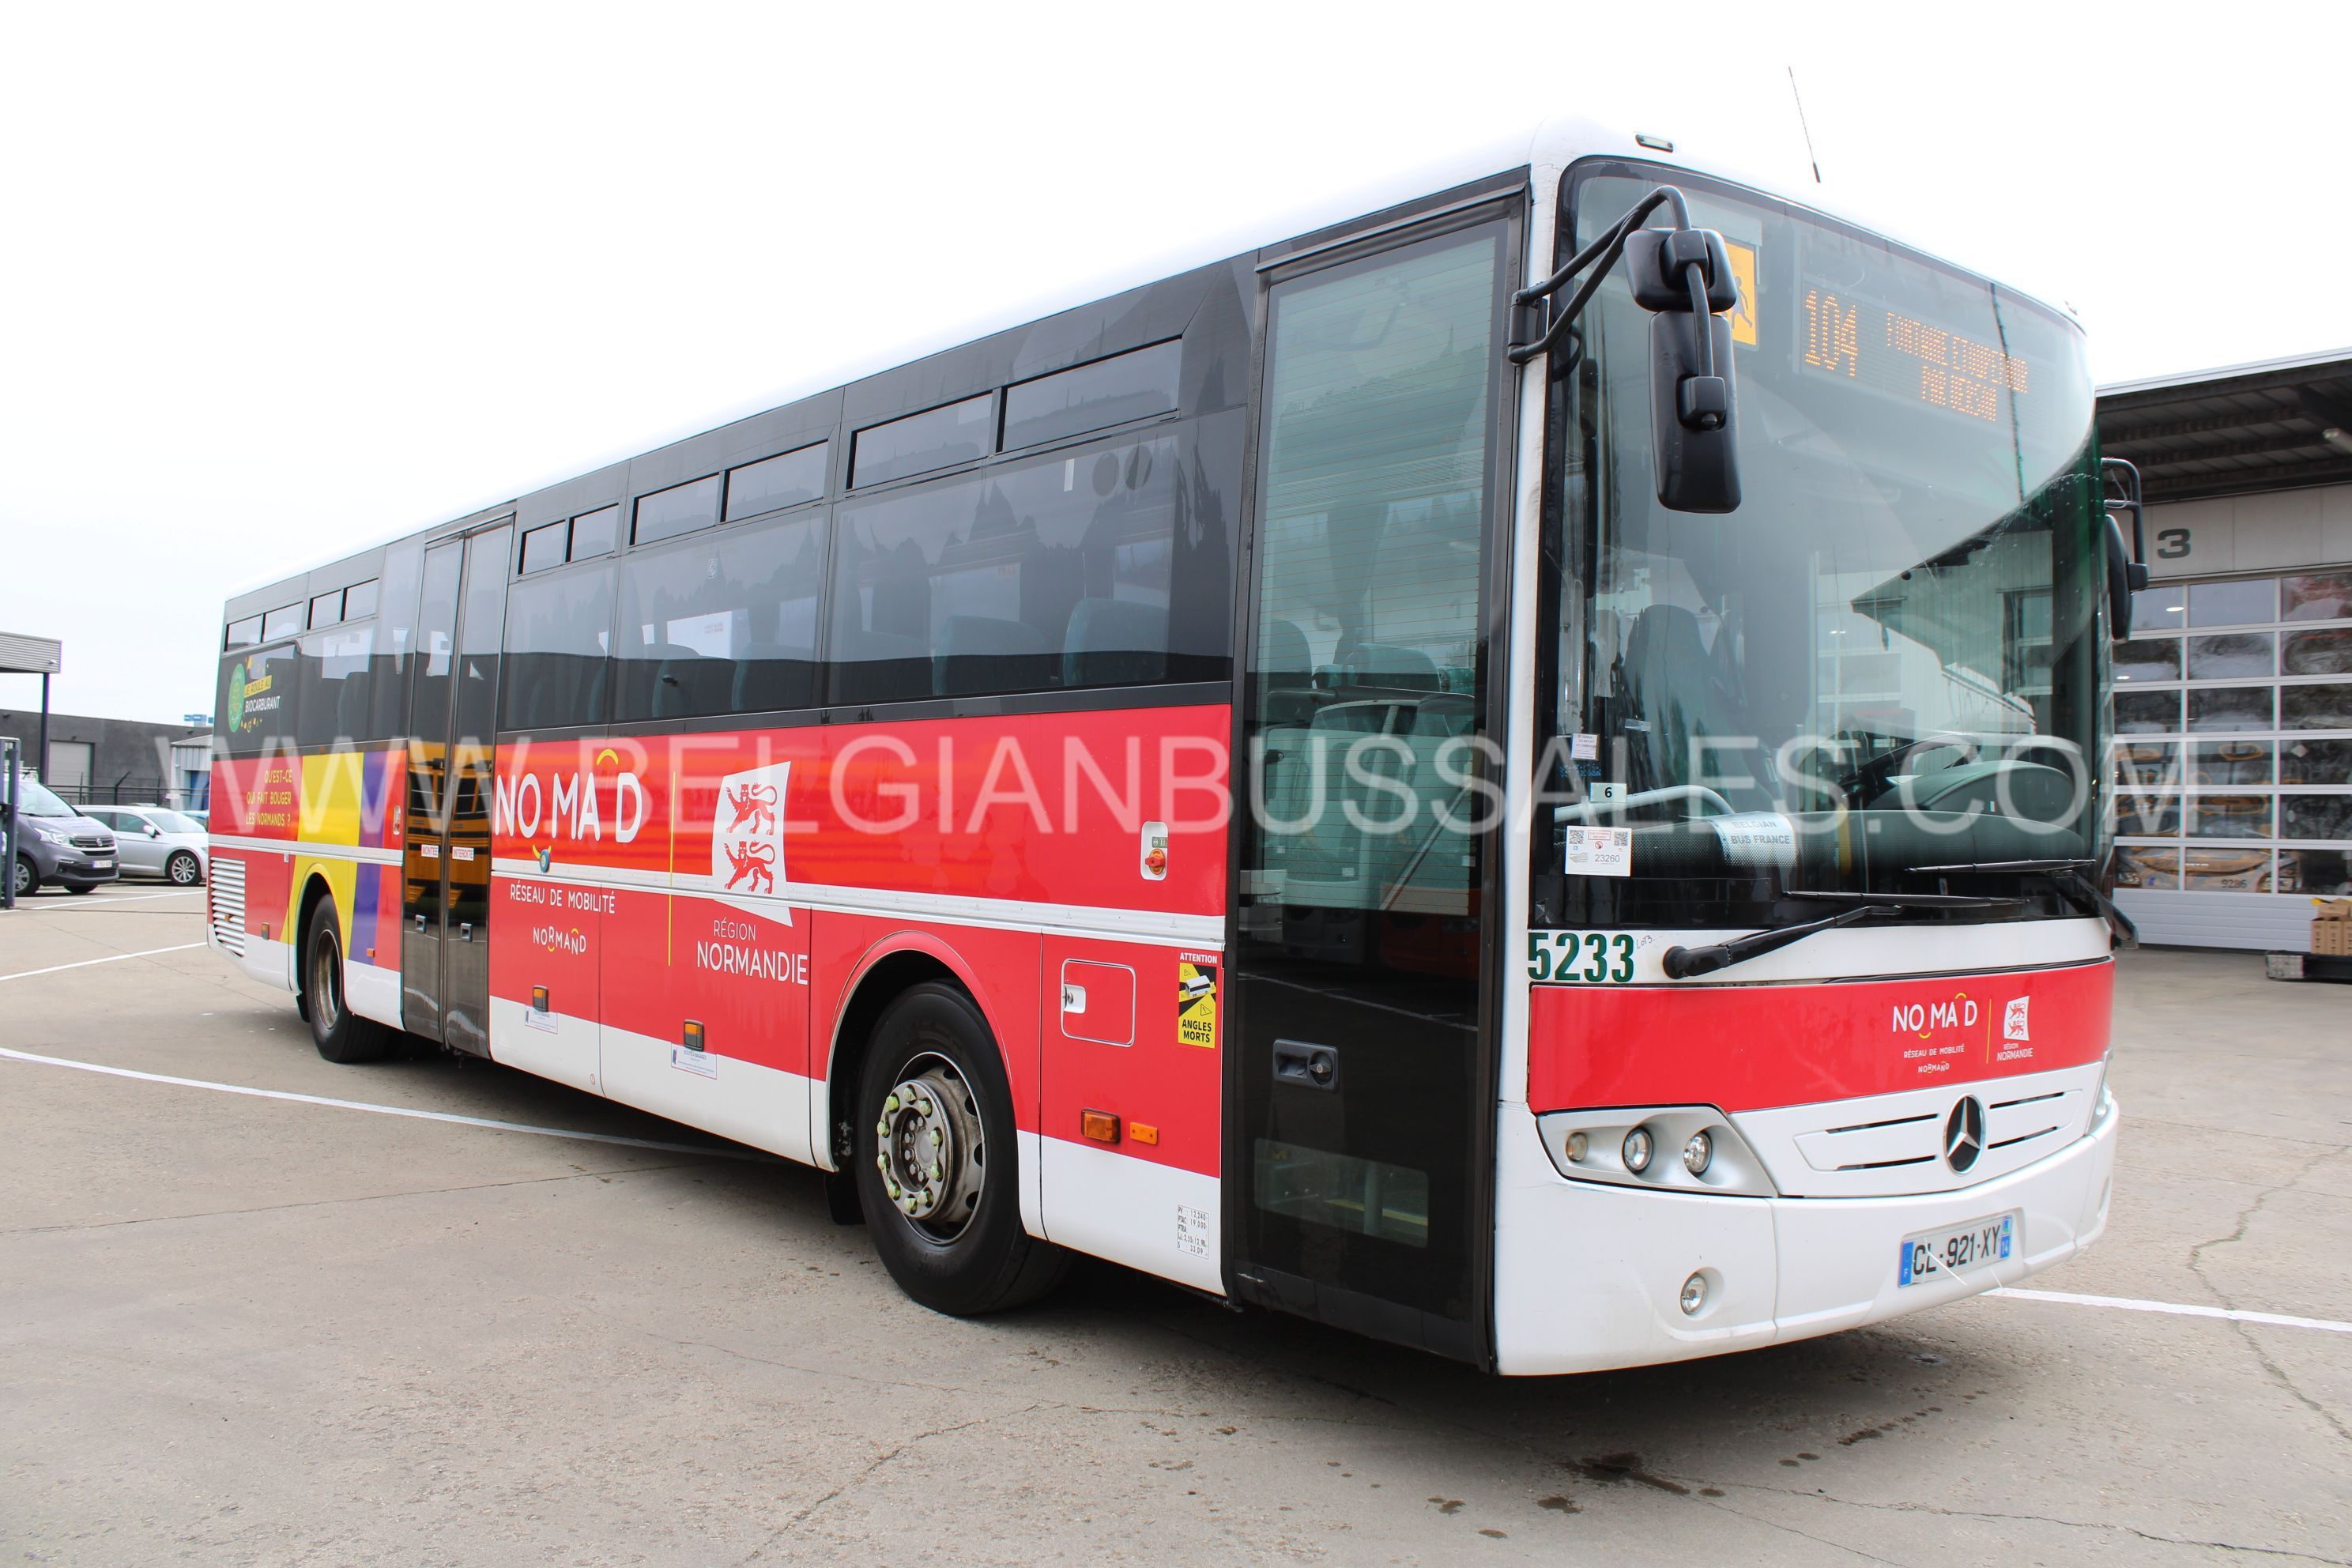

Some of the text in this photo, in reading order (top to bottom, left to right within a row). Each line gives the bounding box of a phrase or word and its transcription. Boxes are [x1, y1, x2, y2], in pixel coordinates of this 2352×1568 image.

[1805, 290, 1858, 377] 104
[2158, 528, 2191, 559] 3
[245, 695, 281, 713] BIOCARBURANT
[247, 791, 292, 805] QUI FAIT BOUGER
[1604, 786, 1612, 797] 6
[246, 812, 255, 825] LES
[257, 812, 285, 827] NORMANDS
[1731, 835, 1790, 844] BUS FRANCE
[1594, 854, 1620, 863] 23260
[510, 880, 616, 914] RÉSEAU DE MOBILITÉ
[714, 917, 756, 941] RÉGION
[533, 925, 586, 955] NORMAND
[697, 940, 808, 986] NORMANDIE
[1179, 952, 1217, 963] ATTENTION
[1528, 932, 1634, 982] 5233
[1182, 1019, 1212, 1032] ANGLES
[1183, 1030, 1210, 1042] MORTS
[1903, 1048, 1927, 1059] RÉSEAU
[1939, 1043, 1966, 1055] MOBILITÉ
[1996, 1047, 2034, 1061] NORMANDIE
[1917, 1062, 1950, 1073] NORMAND
